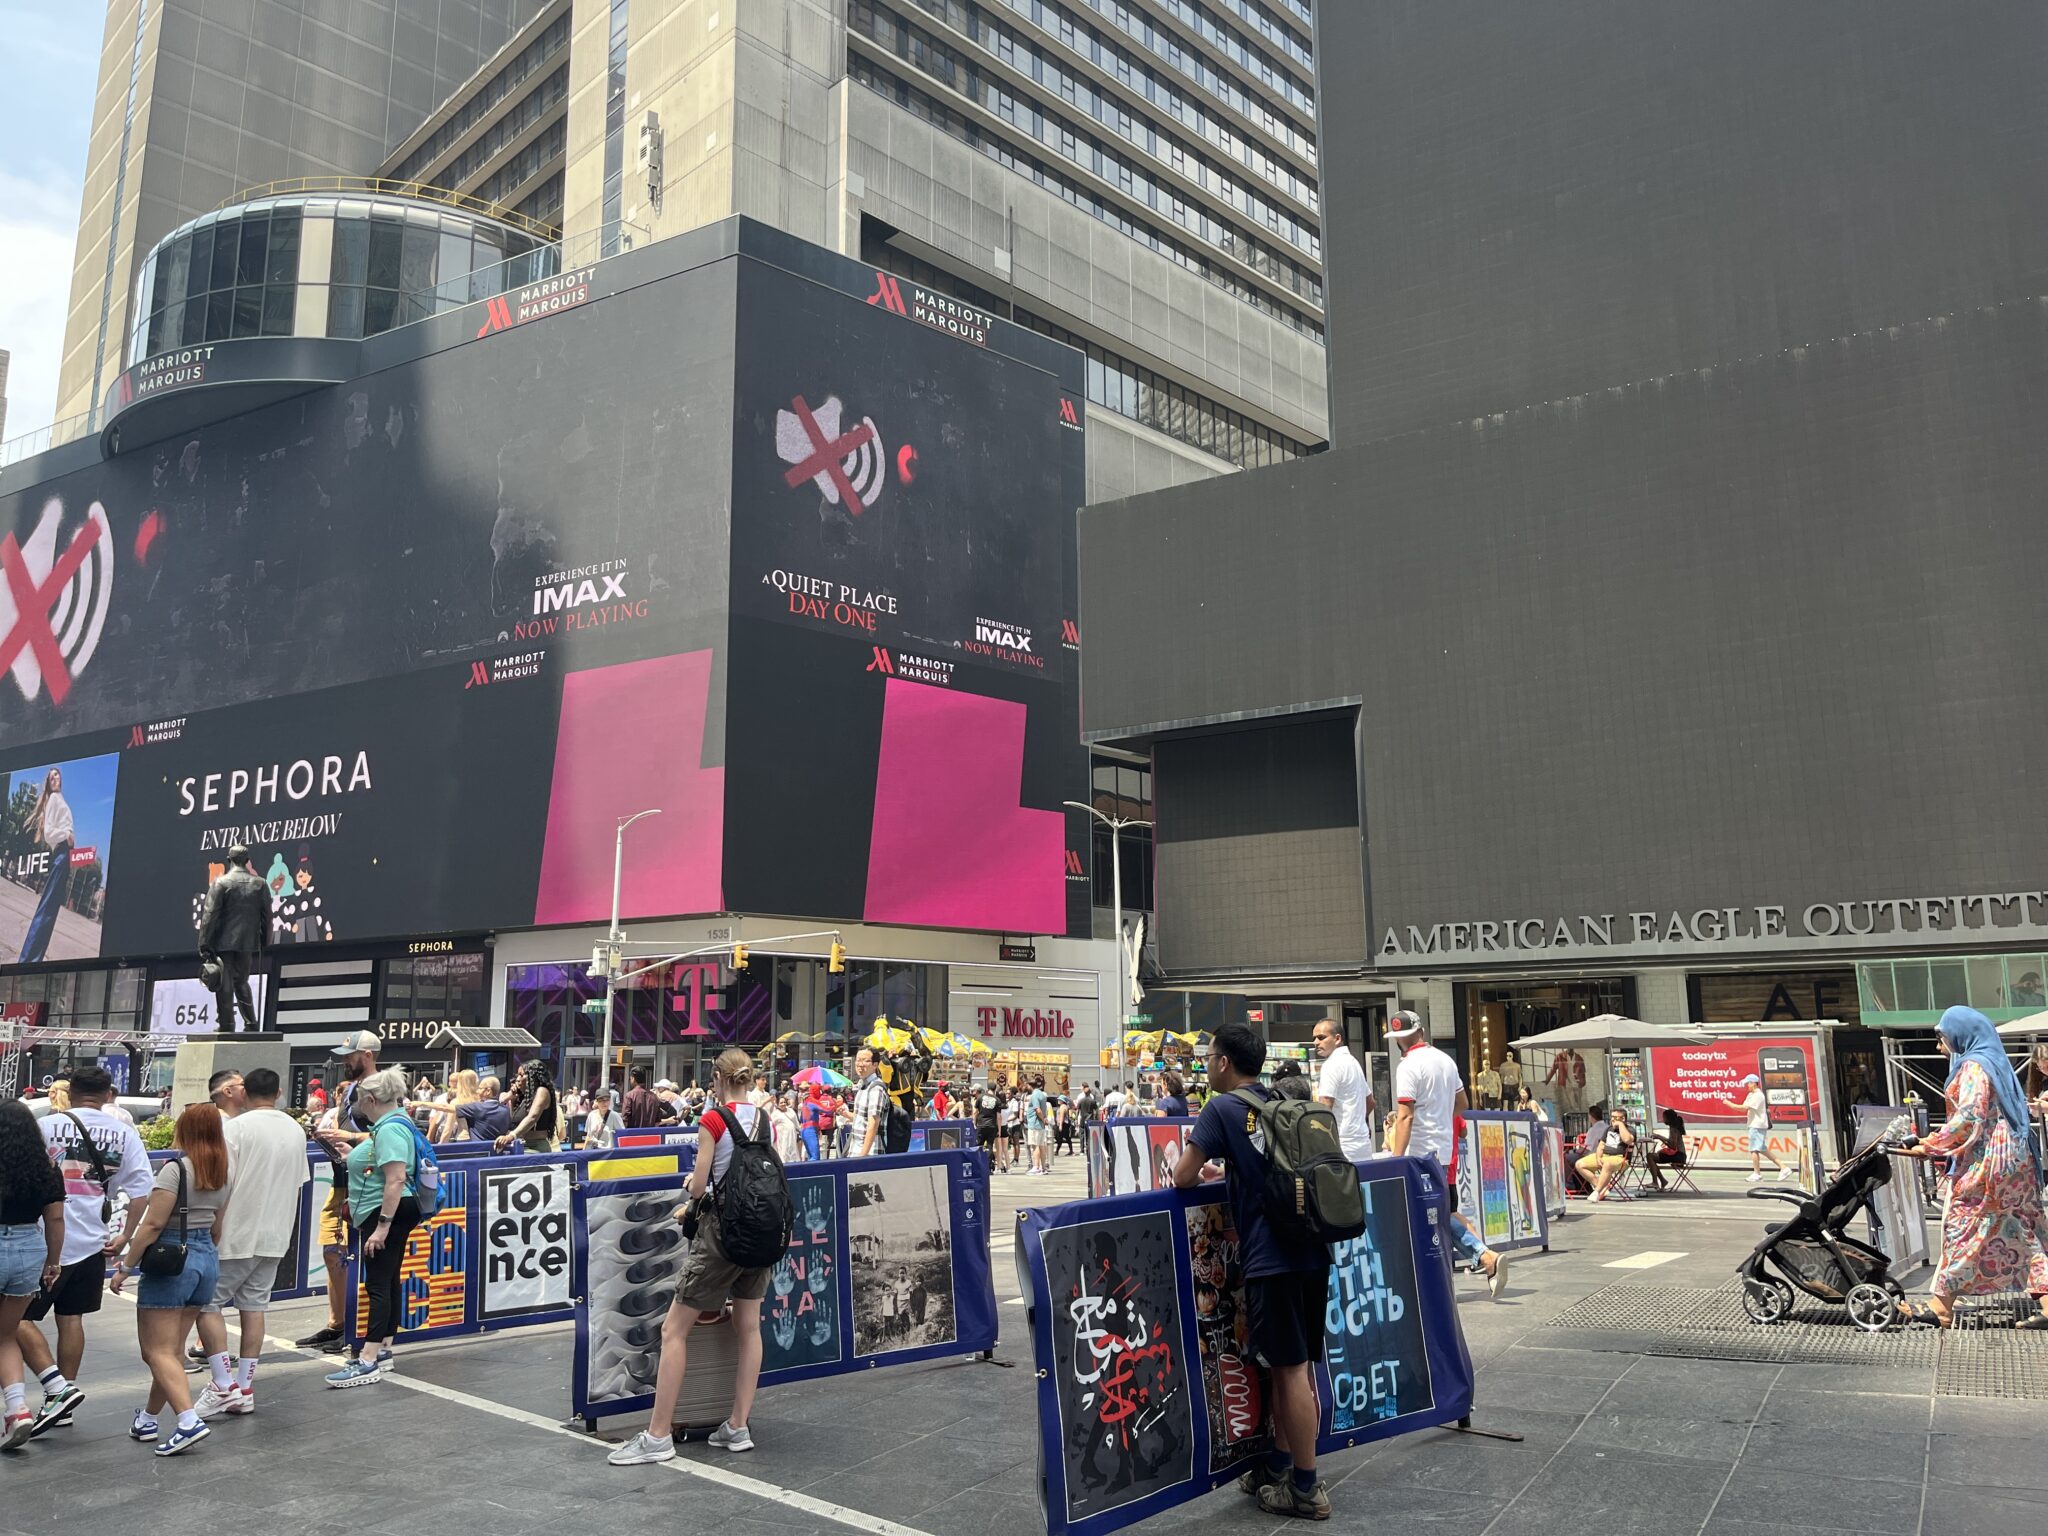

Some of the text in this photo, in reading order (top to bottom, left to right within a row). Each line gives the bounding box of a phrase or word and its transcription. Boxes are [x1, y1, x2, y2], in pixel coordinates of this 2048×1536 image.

[521, 268, 596, 303] MARRIOTT
[519, 288, 585, 319] MARQUIS
[915, 289, 992, 329] MARRIOTT
[915, 306, 984, 342] MARQUIS
[140, 347, 214, 377] MARRIOTT
[138, 366, 201, 394] MARQUIS
[535, 558, 627, 587] EXPERIENCE IT IN
[533, 572, 627, 615] IMAX
[762, 569, 898, 614] A QUIET PLACE
[514, 599, 648, 641] NOW PLAYING
[789, 591, 877, 631] DAY ONE
[975, 625, 1031, 652] IMAX
[976, 616, 1031, 636] EXPERIENCE IT IN
[494, 651, 546, 668] MARRIOTT
[900, 653, 955, 673] MARRIOTT
[964, 640, 993, 656] NOW
[997, 648, 1044, 668] PLAYING
[493, 664, 539, 681] MARQUIS
[900, 665, 949, 684] MARQUIS
[147, 729, 181, 742] MARQUIS
[148, 718, 187, 732] MARRIOTT
[179, 750, 372, 816] SEPHORA
[200, 812, 342, 851] ENTRANCE BELOW
[17, 851, 50, 876] LIFE
[707, 928, 730, 941] 1535
[1382, 891, 2048, 955] AMERICAN EAGLE OUTFITT
[408, 940, 454, 953] SEPHORA
[1001, 1007, 1075, 1039] Mobile
[1682, 1051, 1727, 1061] todaytix
[1669, 1079, 1746, 1089] best tix at your
[1676, 1067, 1737, 1079] Broadway's
[1681, 1089, 1736, 1101] fingertips.
[489, 1175, 553, 1215] Tol
[489, 1212, 567, 1248] era
[489, 1246, 568, 1283] nce
[1335, 1360, 1400, 1411] СВЕТ
